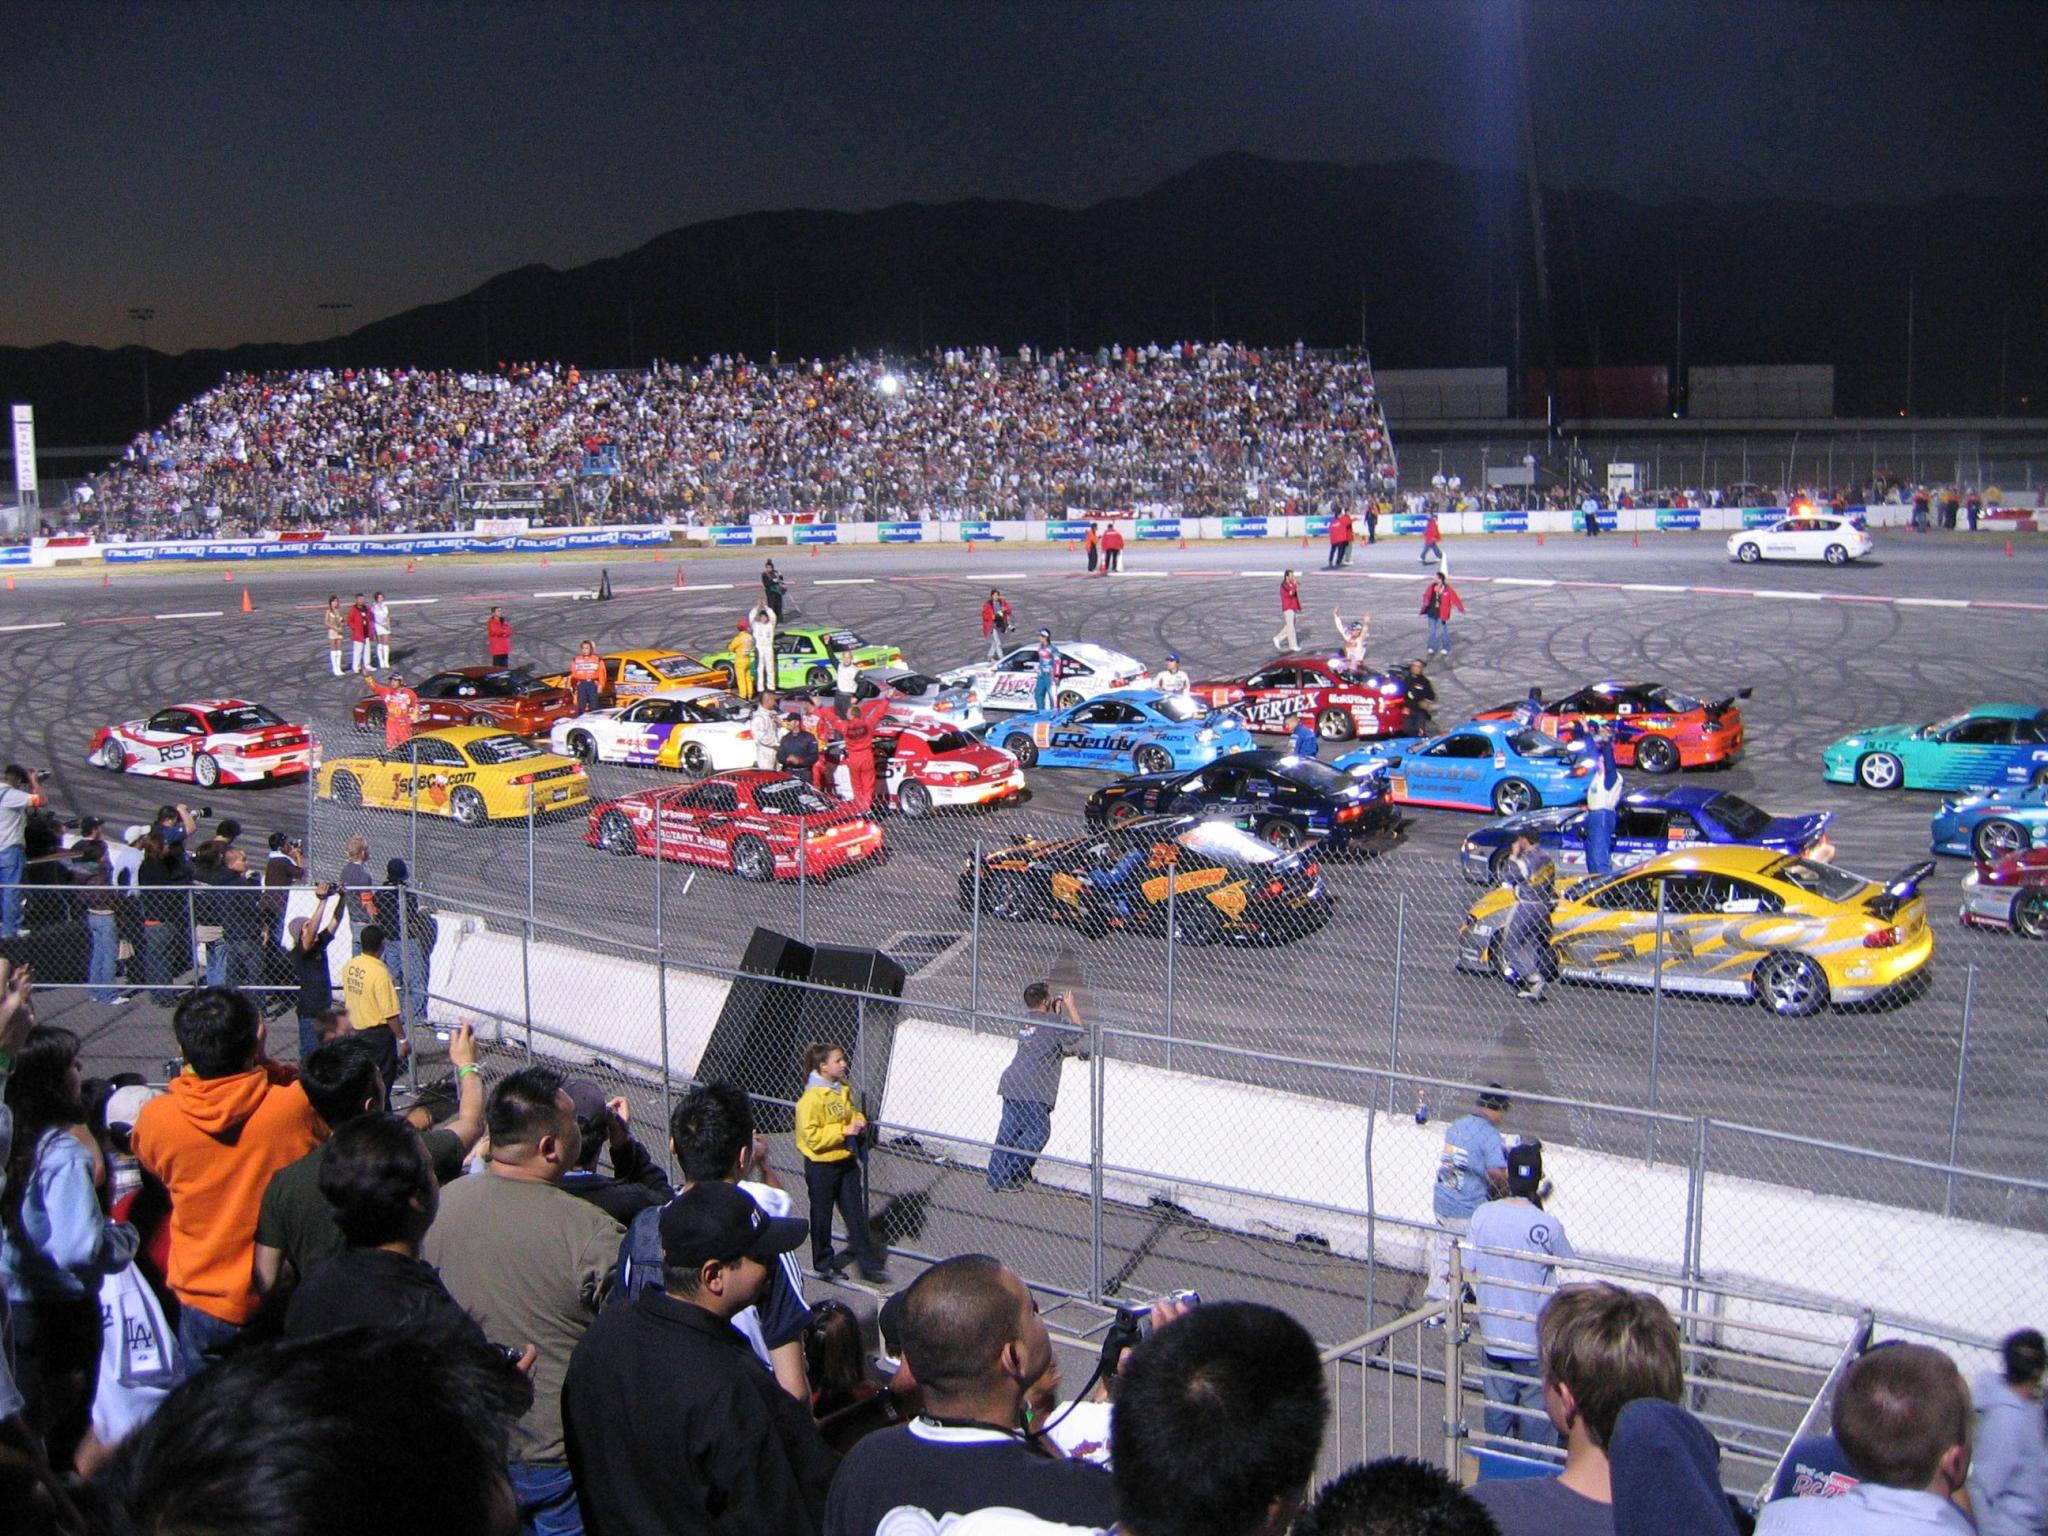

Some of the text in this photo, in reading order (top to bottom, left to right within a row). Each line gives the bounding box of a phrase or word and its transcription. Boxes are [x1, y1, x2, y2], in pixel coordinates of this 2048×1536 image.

[21, 460, 33, 489] TACO
[1744, 513, 1786, 521] FALKEN
[569, 532, 618, 543] FALKEN
[621, 531, 670, 541] FALKEN
[312, 542, 360, 552] FALKEN
[365, 542, 413, 551] FALKEN
[416, 539, 465, 549] FALKEN
[467, 536, 516, 548] FALKEN
[518, 537, 567, 547] FALKEN
[108, 548, 154, 558] FALKEN
[159, 546, 205, 557] FALKEN
[209, 544, 256, 555] FALKEN
[261, 543, 308, 553] FALKEN
[1246, 692, 1320, 722] VERTEX
[348, 966, 366, 979] CSC
[1601, 970, 1626, 980] Line
[128, 1317, 153, 1350] LA
